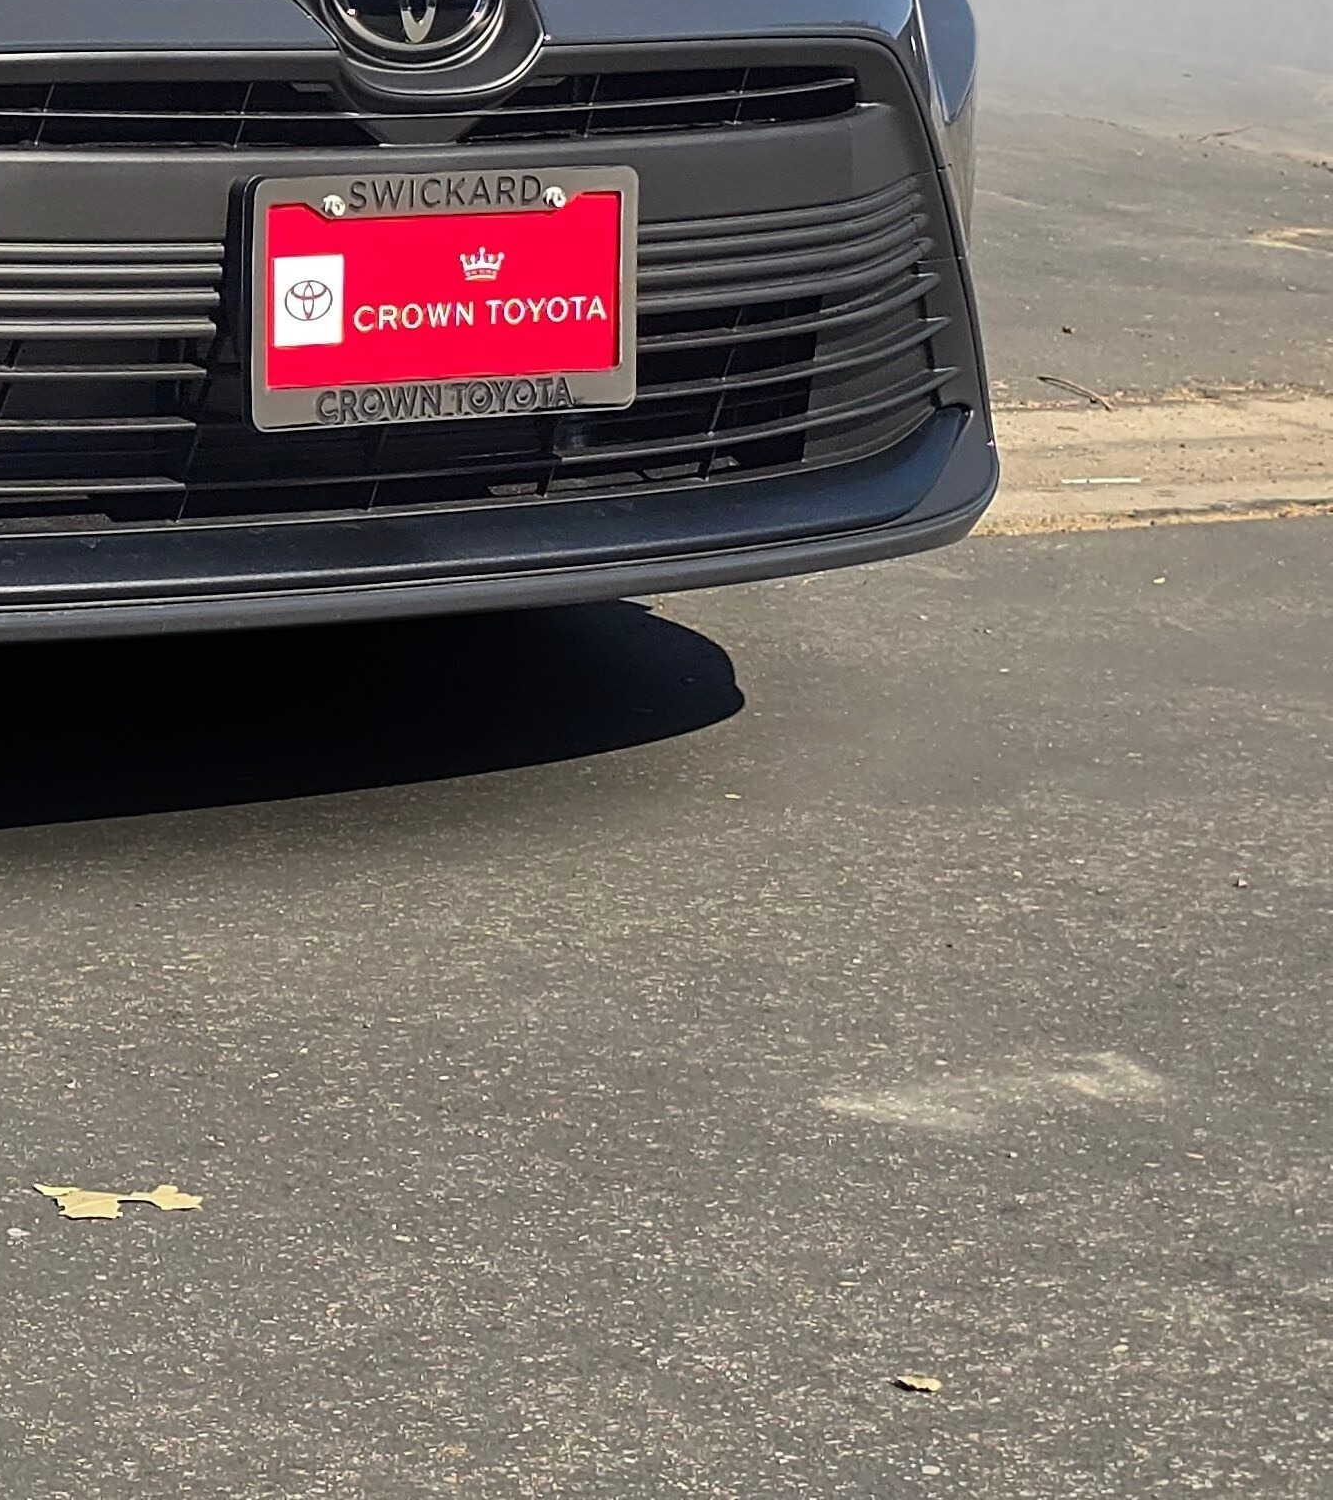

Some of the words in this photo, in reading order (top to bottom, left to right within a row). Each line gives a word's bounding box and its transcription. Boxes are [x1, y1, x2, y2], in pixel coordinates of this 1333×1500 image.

[348, 175, 542, 212] SWICKARD
[353, 301, 475, 333] CROWN
[485, 295, 607, 325] TOYOTA
[315, 387, 442, 424] CROWN
[452, 377, 575, 414] TOYOTA
